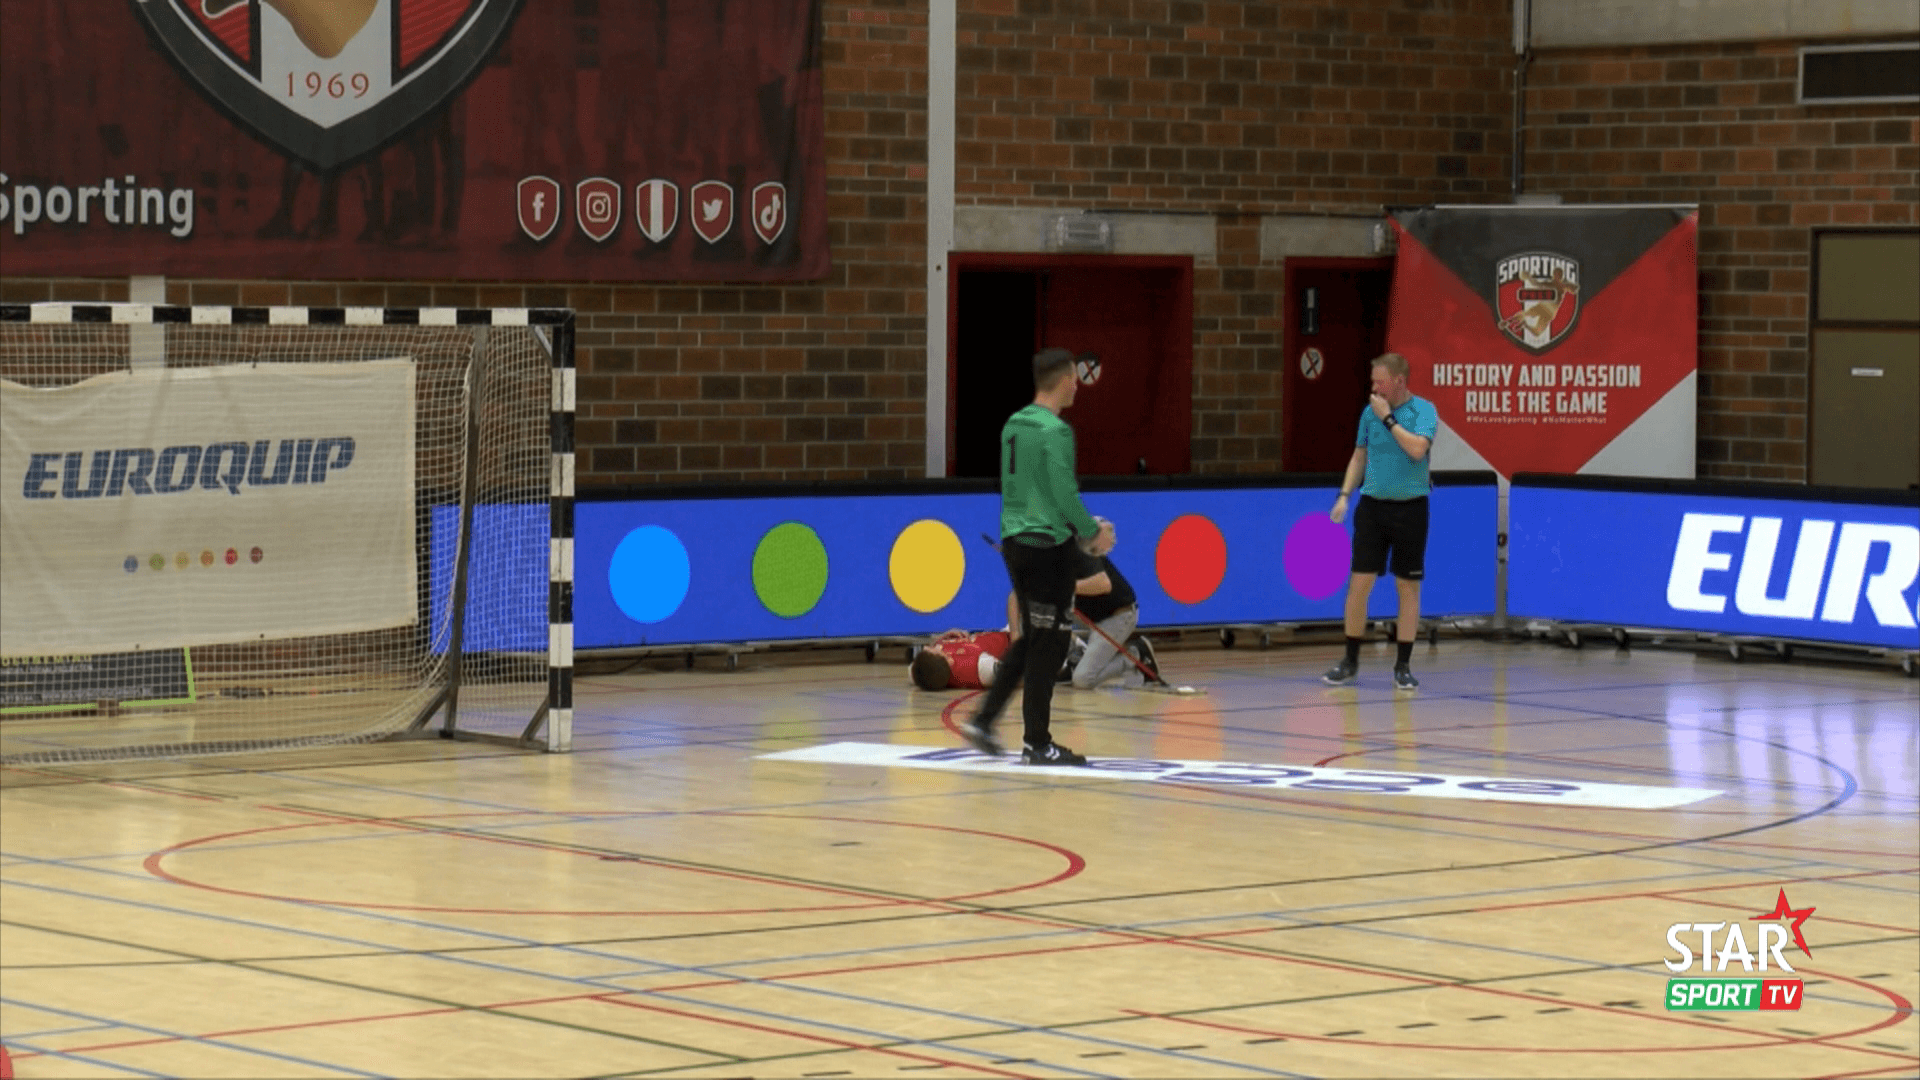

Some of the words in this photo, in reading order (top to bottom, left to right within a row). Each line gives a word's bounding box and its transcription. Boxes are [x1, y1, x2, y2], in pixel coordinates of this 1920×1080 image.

[288, 71, 369, 99] 1969
[1499, 255, 1577, 285] SPORTING
[1433, 363, 1514, 387] HISTORY
[1518, 364, 1556, 388] AND
[1561, 364, 1641, 388] PASSION
[1465, 390, 1512, 413] RULE
[1517, 390, 1551, 414] THE
[1556, 390, 1608, 414] GAME
[22, 436, 356, 499] EUROQUIP
[1007, 435, 1017, 475] 1
[1666, 512, 1920, 628] EUR
